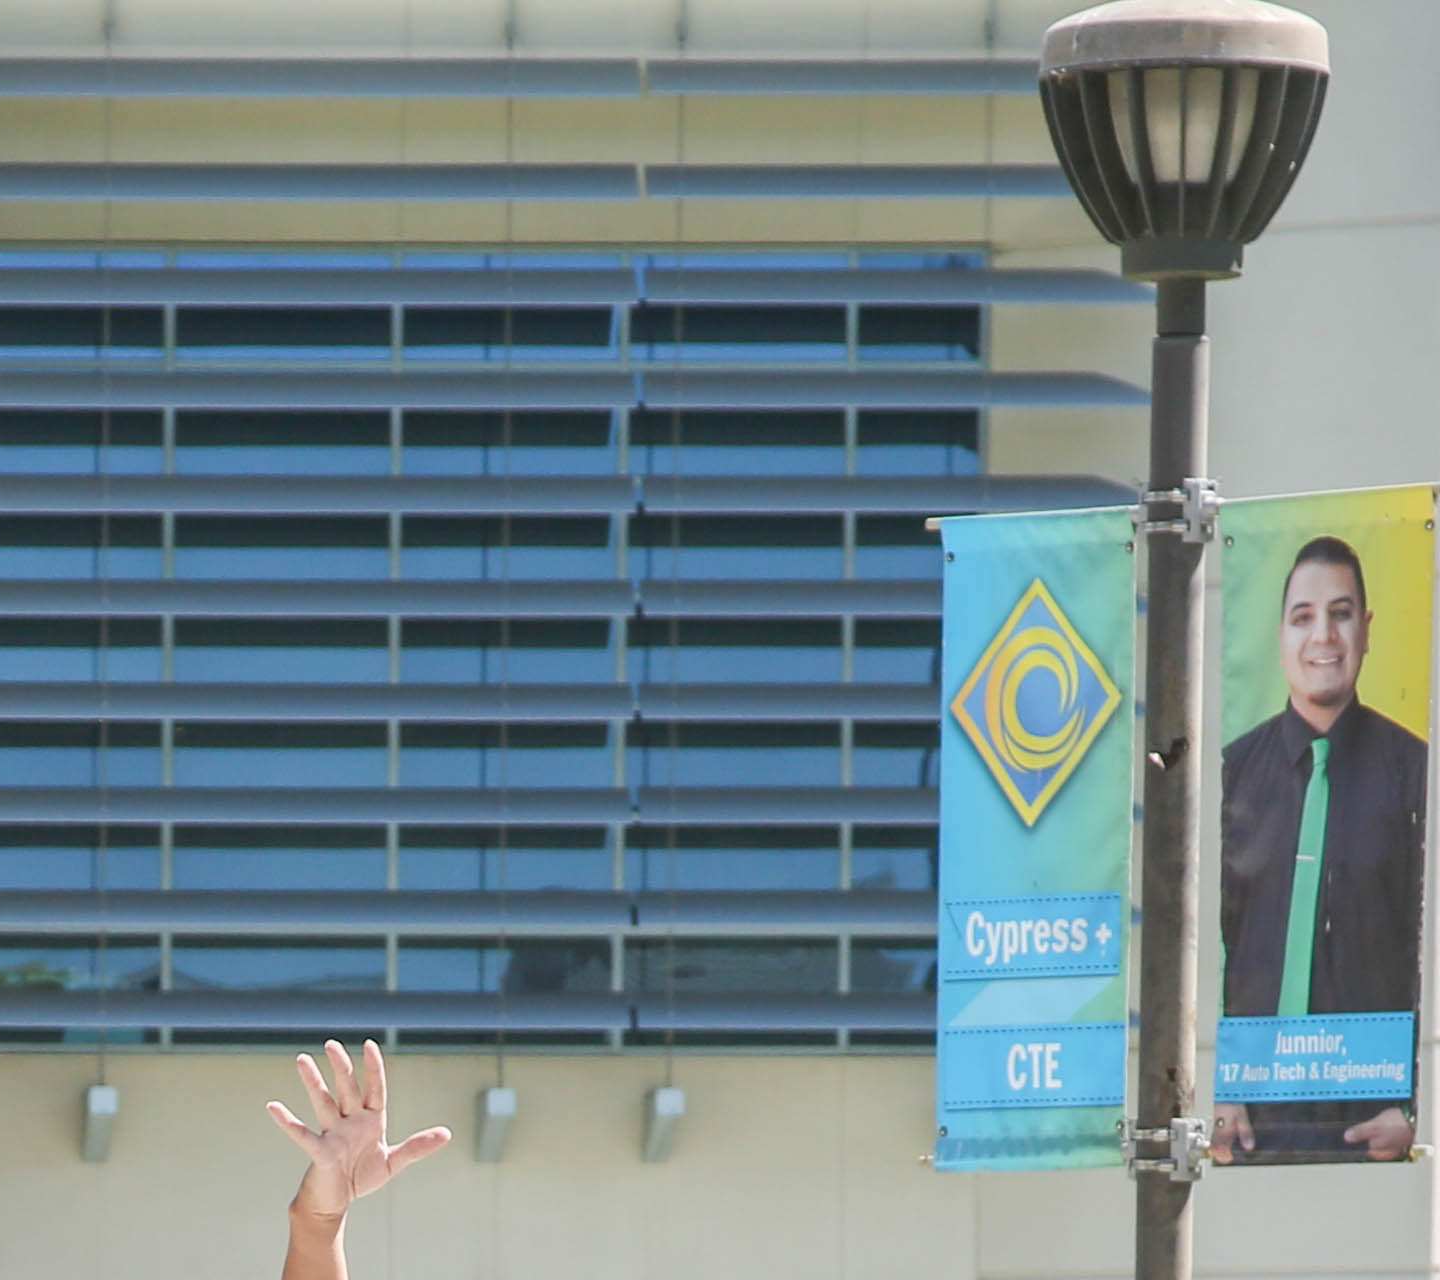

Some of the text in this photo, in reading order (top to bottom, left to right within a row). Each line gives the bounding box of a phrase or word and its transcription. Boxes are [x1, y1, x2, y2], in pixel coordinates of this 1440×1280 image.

[965, 910, 1089, 966] Cypress
[1274, 1029, 1348, 1057] Junnior,
[1006, 1042, 1063, 1091] CTE
[1242, 1063, 1270, 1082] Auto
[1272, 1062, 1306, 1081] Tech
[1308, 1061, 1320, 1081] &
[1323, 1058, 1406, 1084] Engineering
